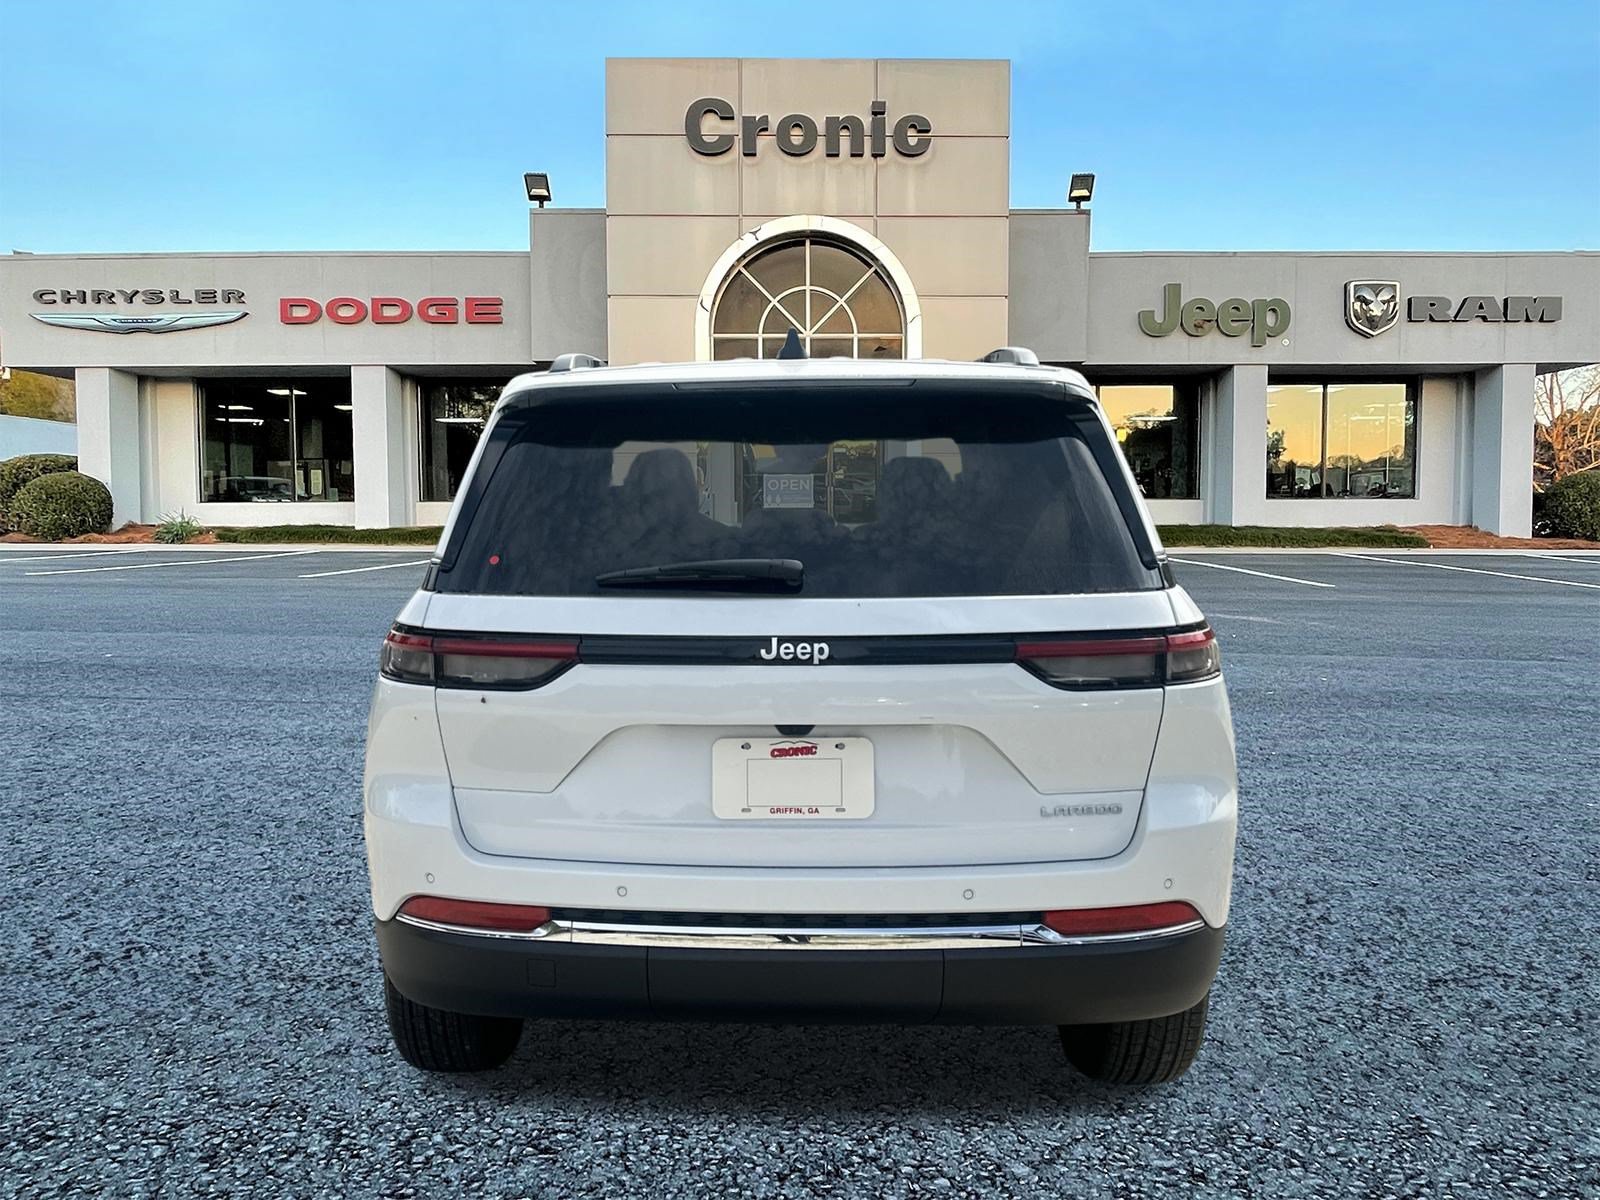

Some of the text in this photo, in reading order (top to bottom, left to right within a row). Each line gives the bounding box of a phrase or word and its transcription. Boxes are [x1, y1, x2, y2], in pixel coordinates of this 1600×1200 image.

[684, 97, 932, 158] Cronic
[32, 289, 246, 304] CHRYSLER
[1407, 296, 1563, 323] RAM
[279, 297, 503, 325] DODGE
[1138, 283, 1291, 347] Jeep
[767, 479, 810, 490] OPEN
[760, 637, 830, 664] Jeep
[770, 807, 805, 815] GRIFFIN,
